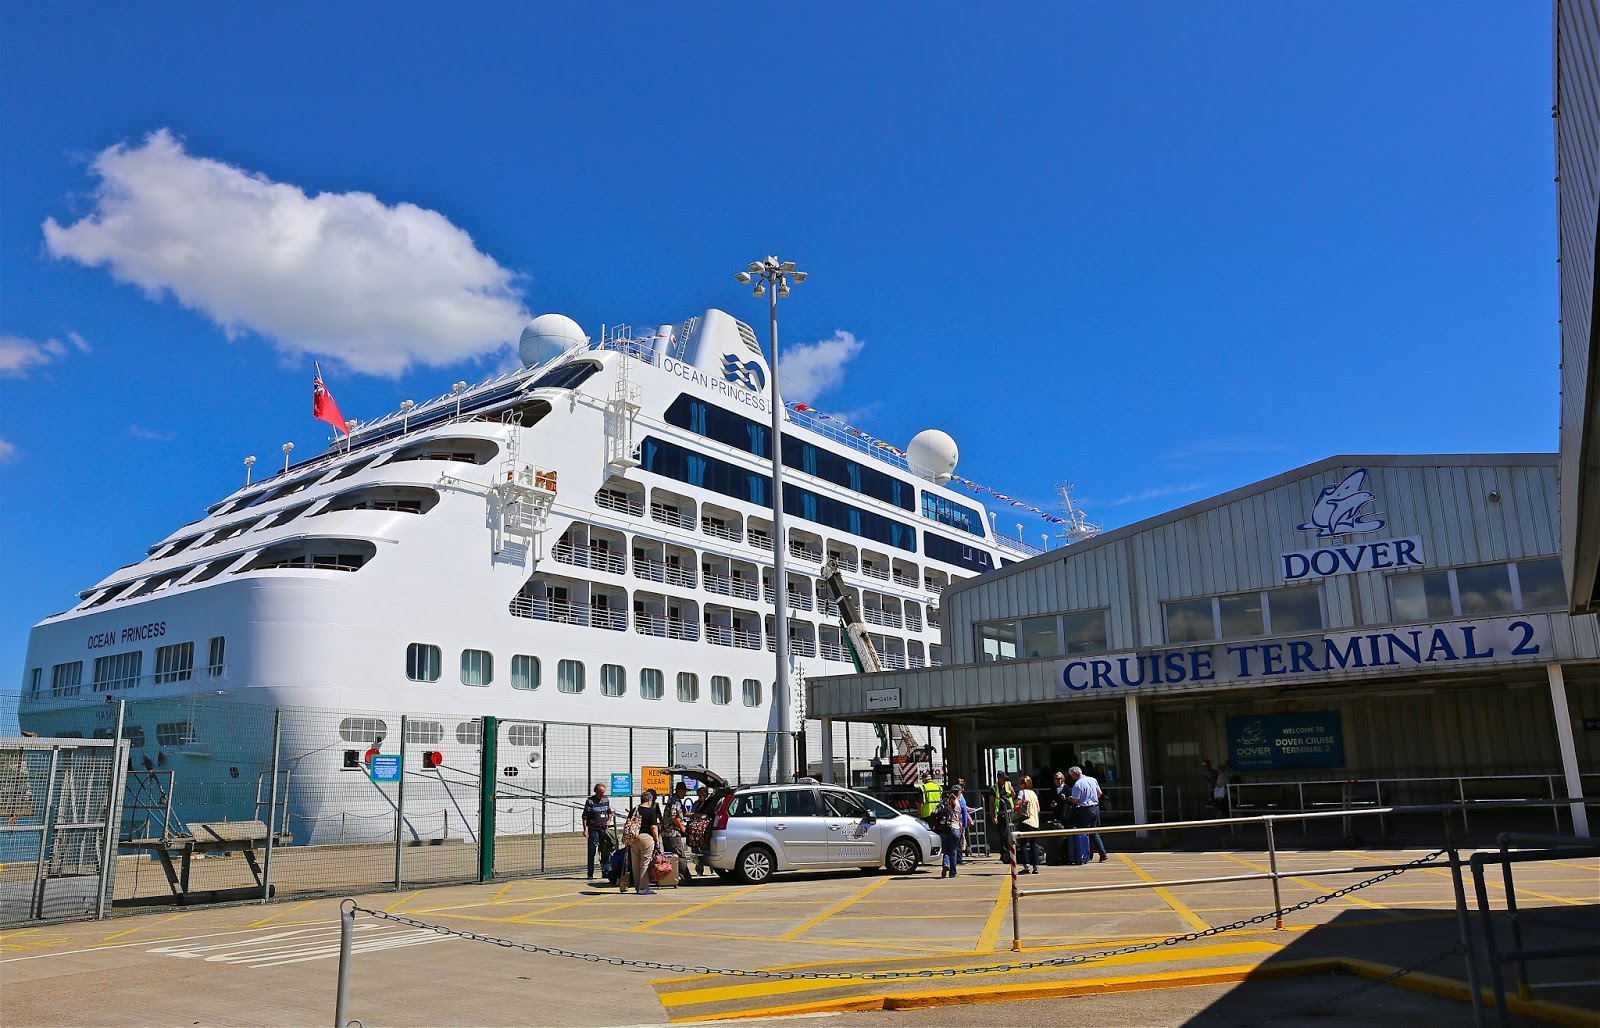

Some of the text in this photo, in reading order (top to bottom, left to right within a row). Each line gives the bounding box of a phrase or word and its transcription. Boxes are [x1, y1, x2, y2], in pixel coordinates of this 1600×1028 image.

[663, 358, 766, 412] OCEAN PRINCESS
[1281, 539, 1423, 579] DOVER
[87, 621, 166, 650] OCEAN PRINCESS
[1062, 621, 1540, 691] CRUISE TERMINAL 2
[1237, 747, 1271, 755] DOVER
[1281, 746, 1323, 754] TERMINAL
[1305, 737, 1334, 745] CRUISE
